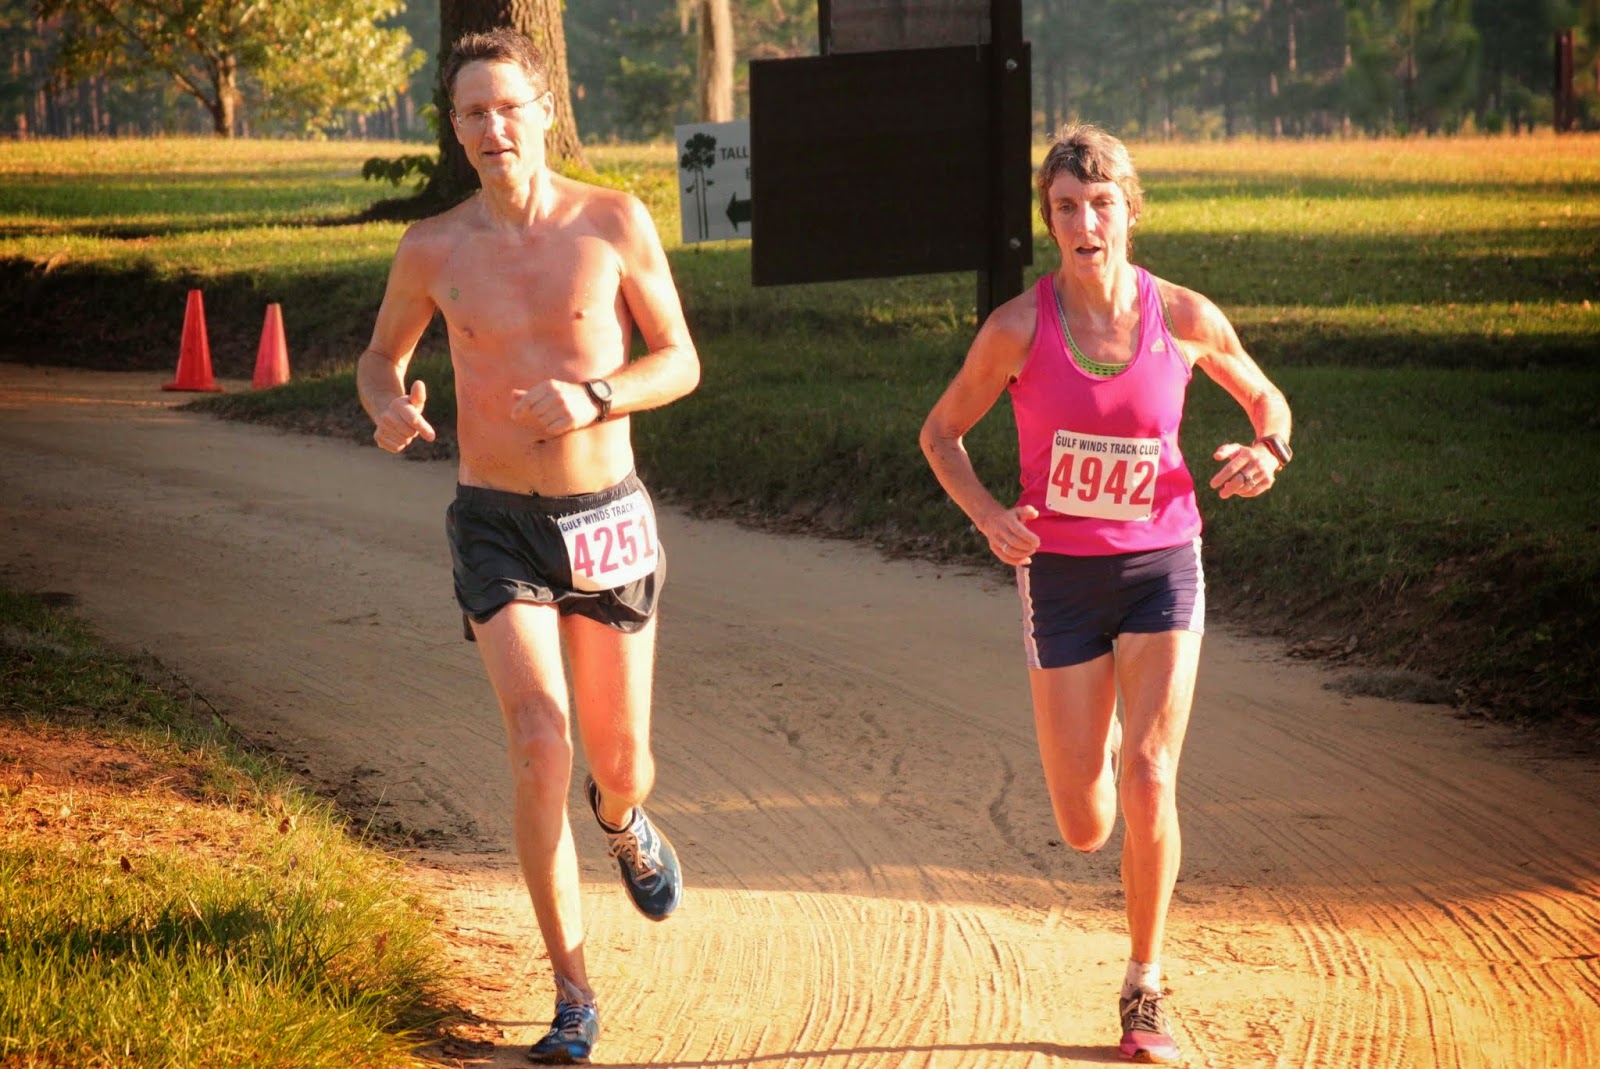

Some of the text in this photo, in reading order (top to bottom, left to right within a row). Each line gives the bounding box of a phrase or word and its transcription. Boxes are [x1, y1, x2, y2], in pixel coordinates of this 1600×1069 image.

[719, 146, 749, 160] TALL
[1055, 435, 1159, 456] GULF WINDS TRACK CLUB
[1051, 453, 1155, 505] 4942
[561, 519, 582, 532] GULF
[582, 509, 611, 526] WINDS
[611, 502, 635, 517] TRACK
[574, 515, 654, 578] 4251
